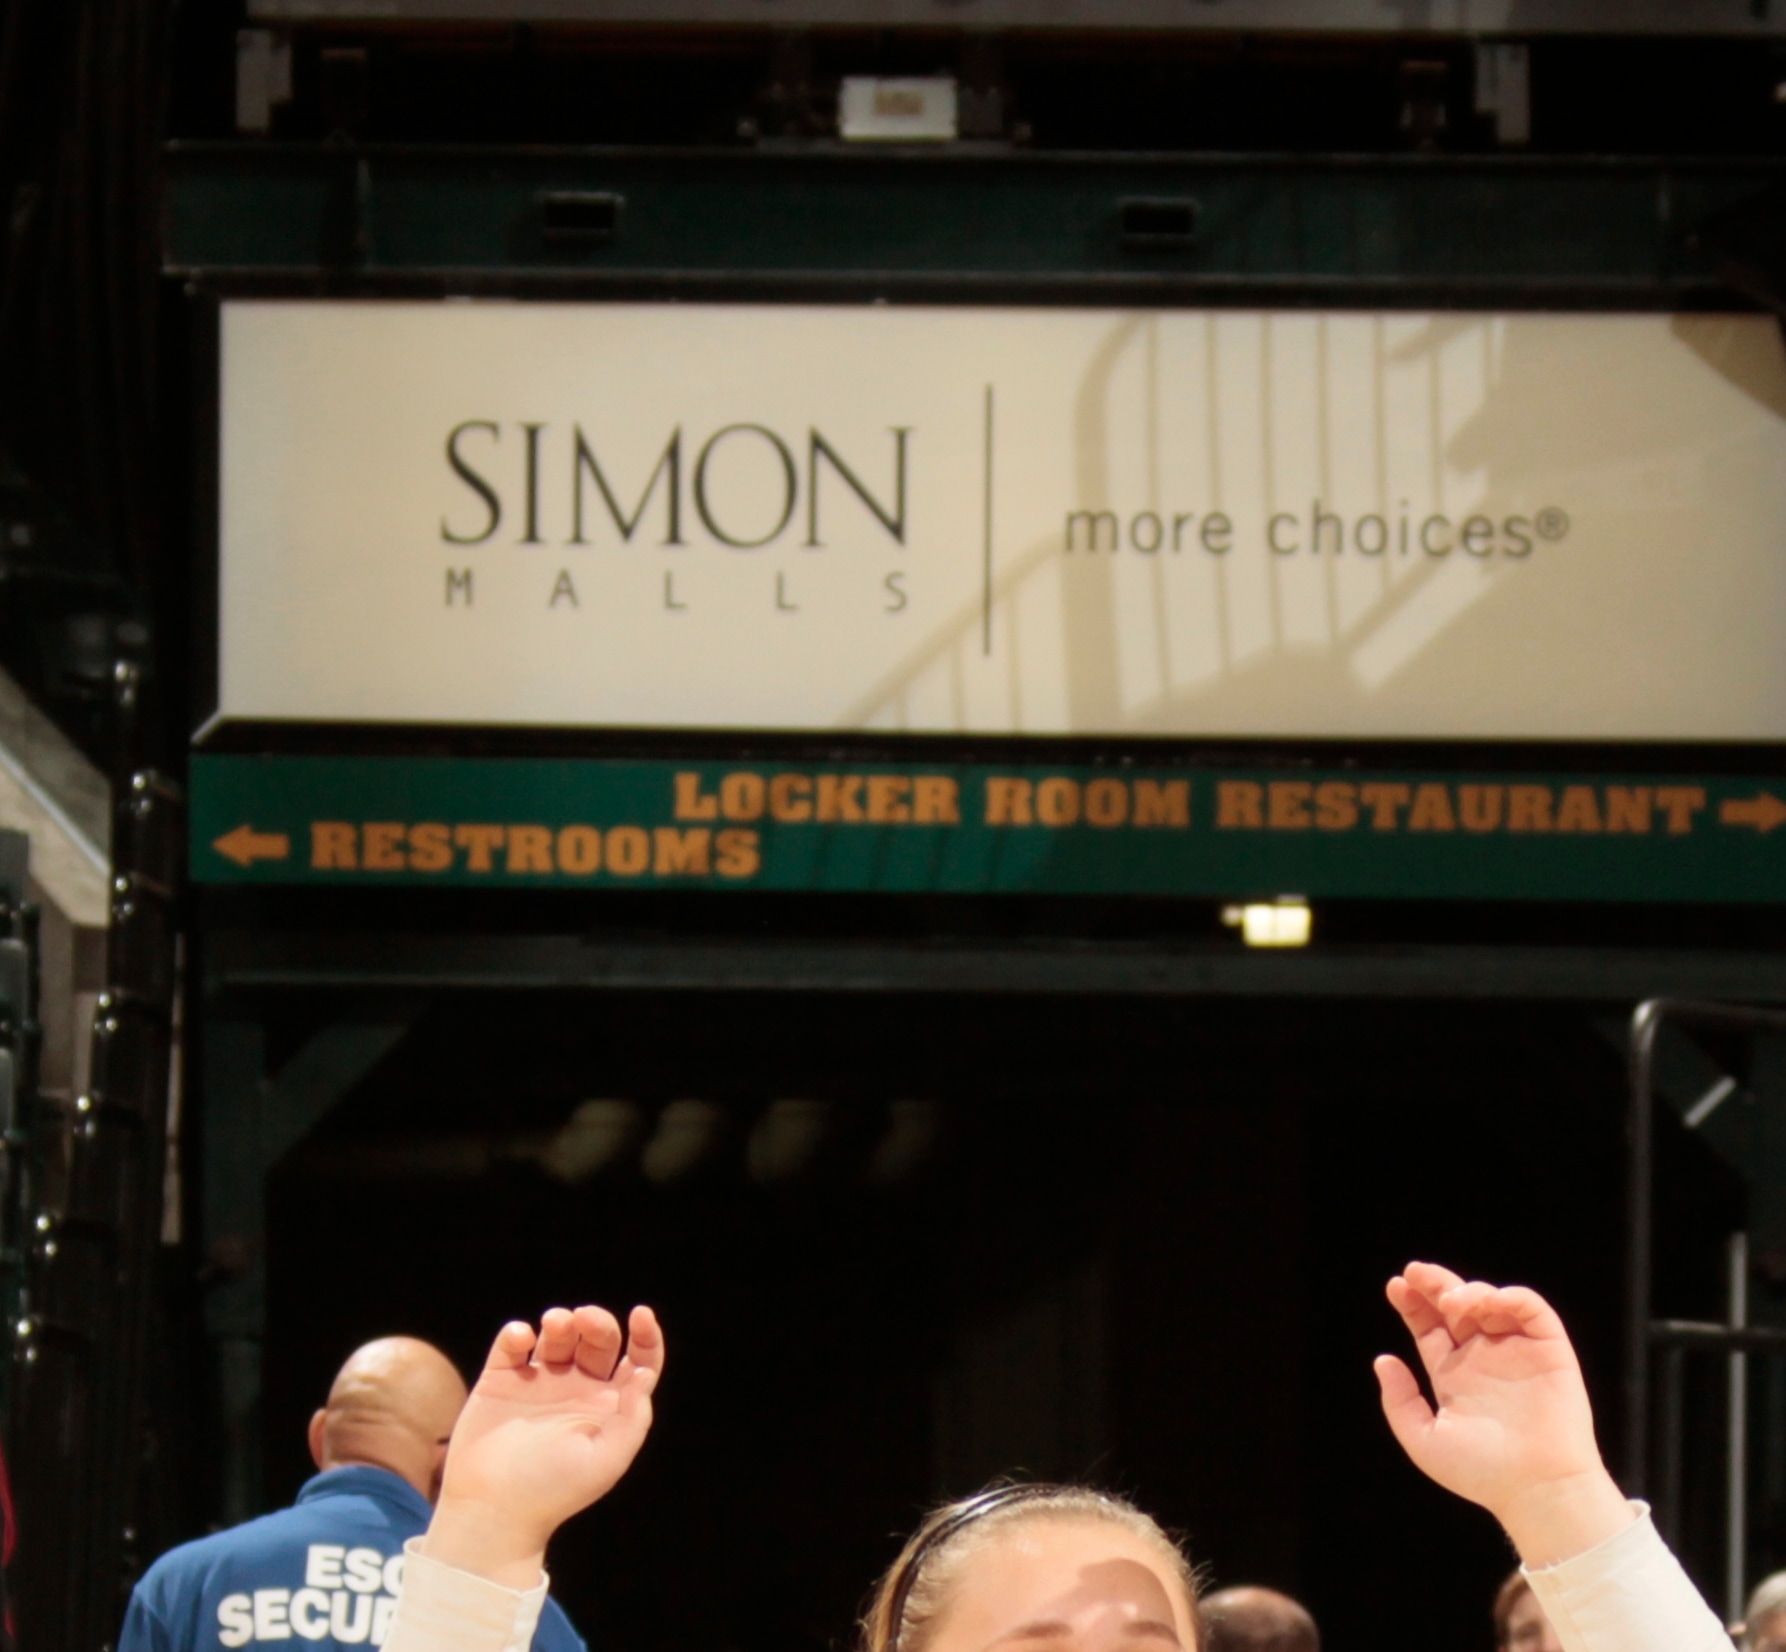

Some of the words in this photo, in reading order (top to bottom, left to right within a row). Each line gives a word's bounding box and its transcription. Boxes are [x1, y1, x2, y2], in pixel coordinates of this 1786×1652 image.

[440, 419, 915, 548] SIMON
[1065, 508, 1233, 556] more
[444, 567, 907, 612] MALLS
[673, 771, 960, 824] LOCKER
[984, 776, 1192, 828] ROOM
[1216, 780, 1706, 835] RESTAURANT
[310, 821, 760, 878] RESTROOMS
